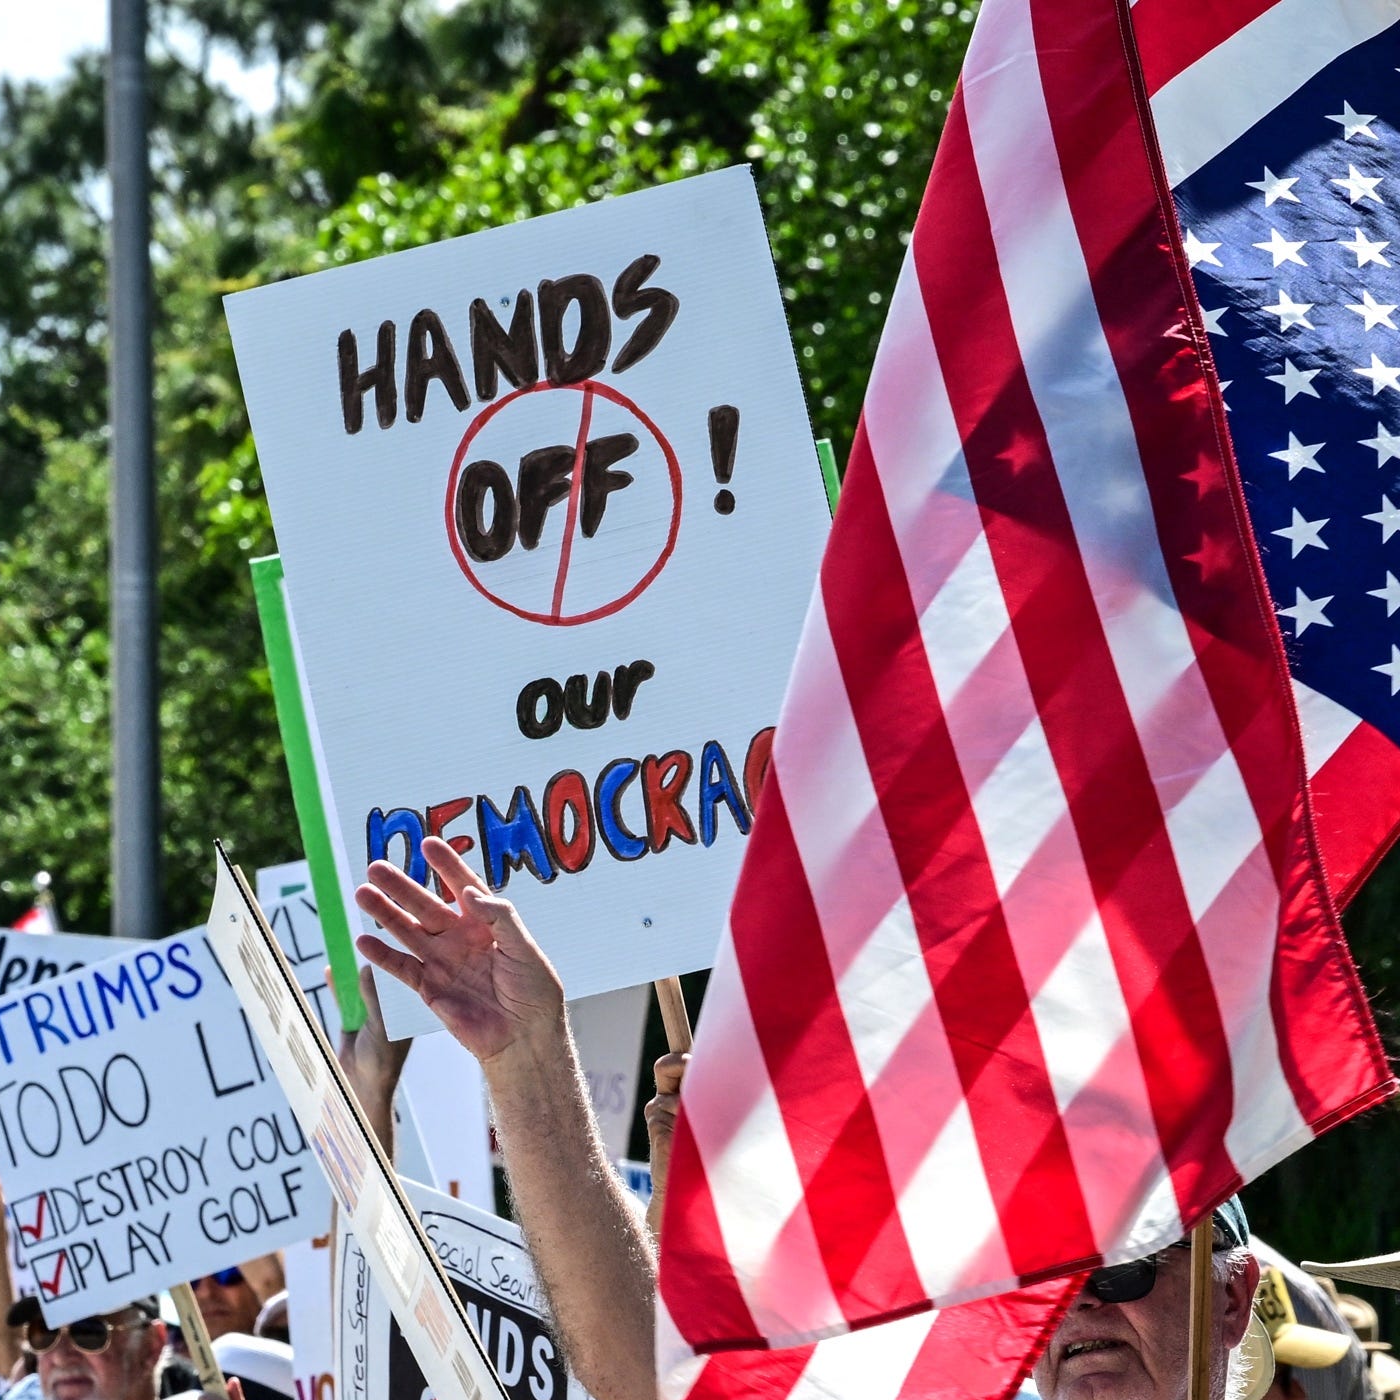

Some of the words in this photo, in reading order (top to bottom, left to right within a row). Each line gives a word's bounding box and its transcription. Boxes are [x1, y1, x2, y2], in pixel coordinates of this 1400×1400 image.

[337, 254, 680, 434] HANDS
[457, 431, 640, 563] OFF
[516, 659, 655, 740] our
[56, 1137, 209, 1234] DESTROY
[70, 1213, 173, 1285] PLAY
[199, 1166, 306, 1246] GOLF
